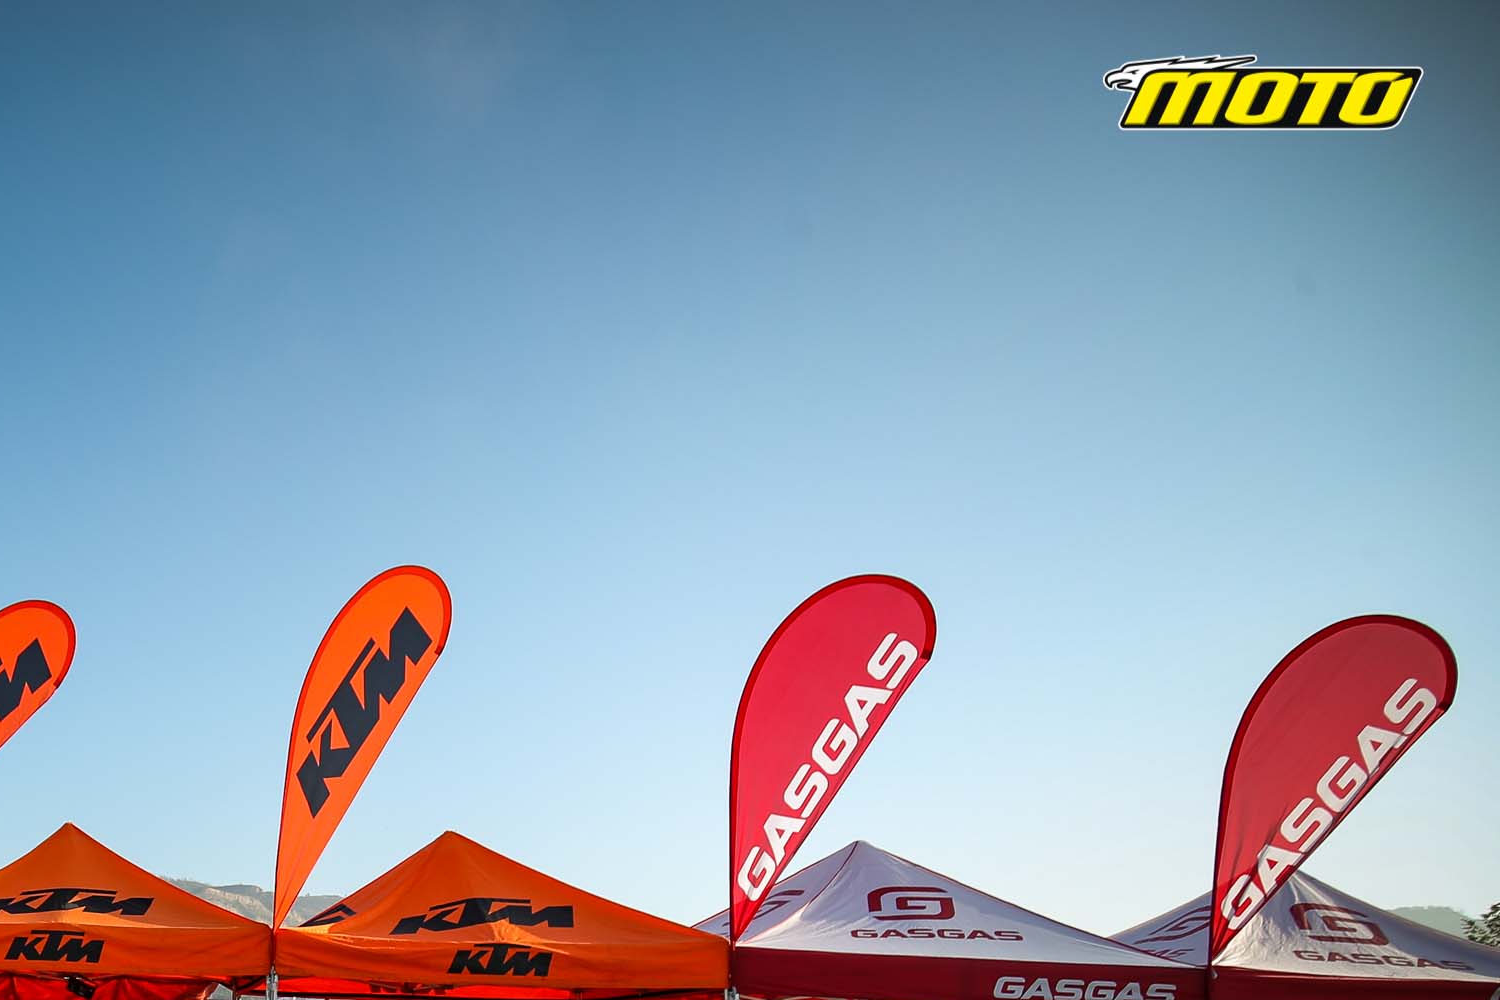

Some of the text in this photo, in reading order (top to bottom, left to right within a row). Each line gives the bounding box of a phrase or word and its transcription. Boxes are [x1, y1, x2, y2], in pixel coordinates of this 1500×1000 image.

[296, 606, 432, 819] KTM
[737, 632, 918, 902] GASGAS
[1221, 678, 1437, 931] GASGAS
[389, 897, 575, 935] KTM
[4, 929, 106, 963] KTM
[850, 928, 1024, 942] GASGAS
[447, 943, 553, 977] KTM
[1293, 949, 1475, 971] GASGAS
